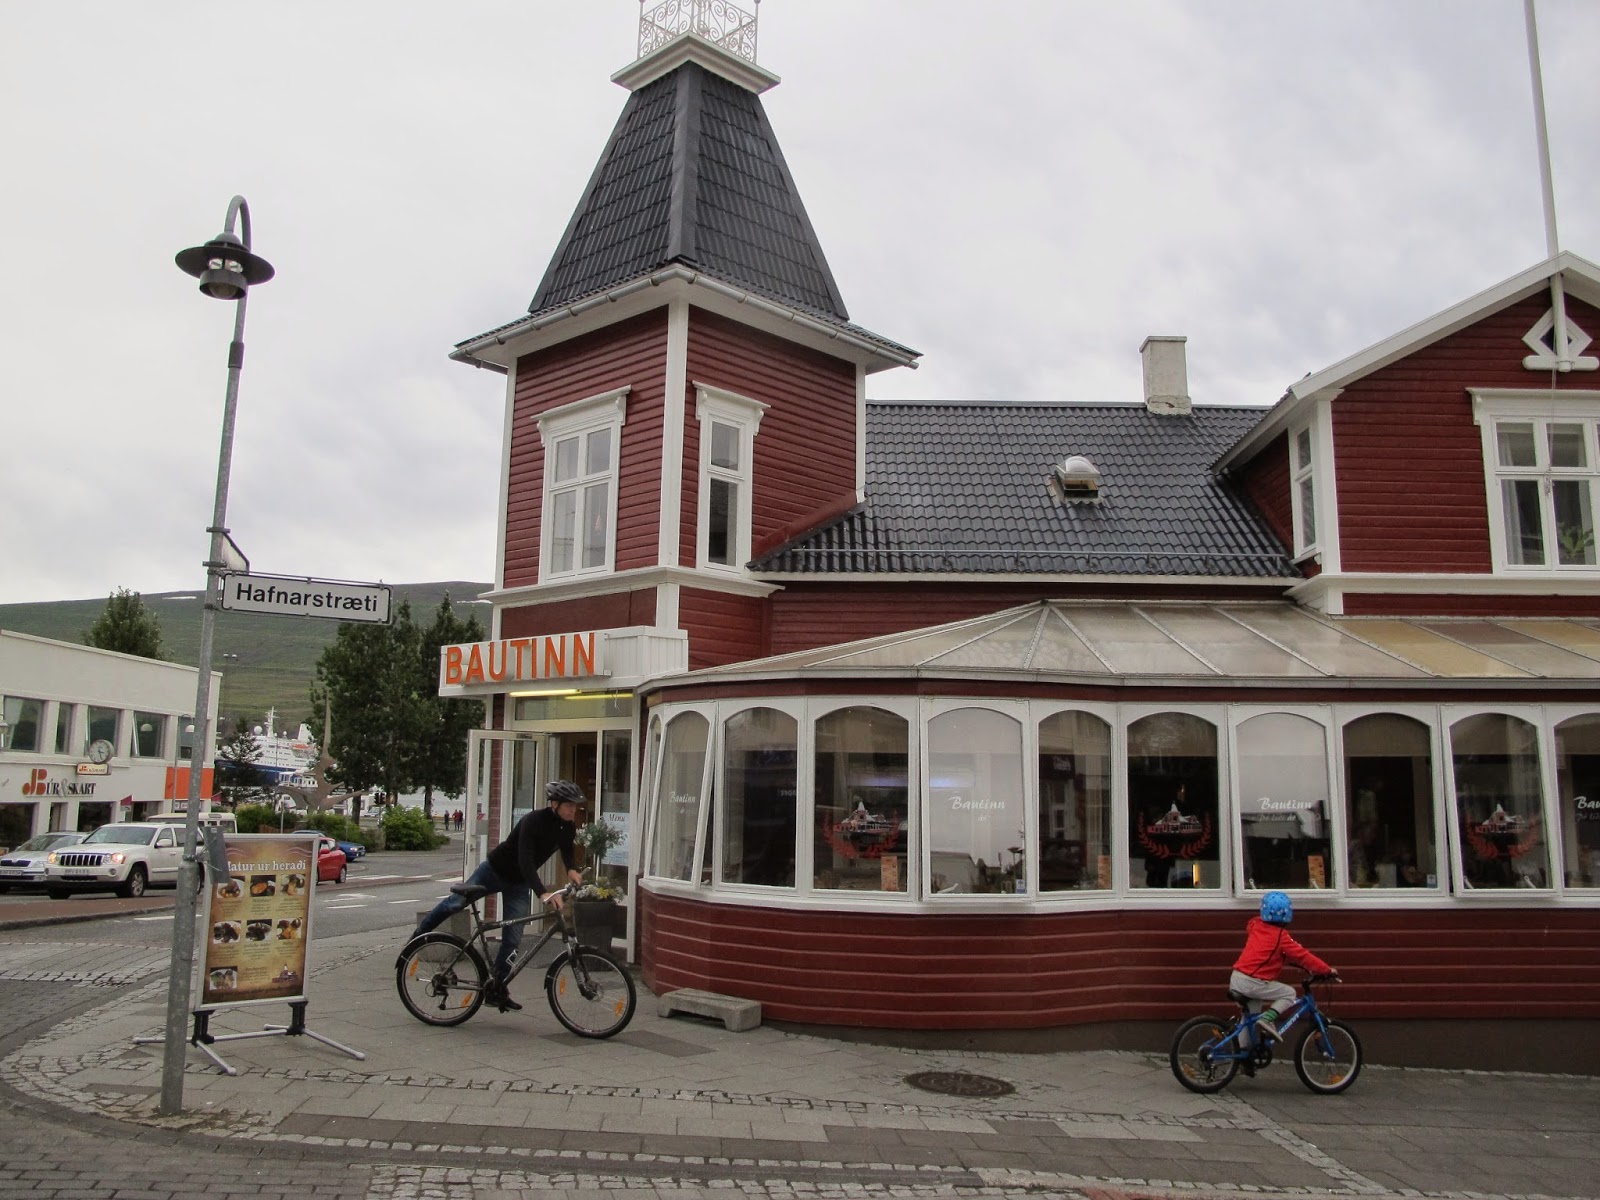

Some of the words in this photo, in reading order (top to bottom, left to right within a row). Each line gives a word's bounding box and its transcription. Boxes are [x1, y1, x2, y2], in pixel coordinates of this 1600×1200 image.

[236, 582, 378, 612] Hafnarstræti
[446, 632, 595, 685] BAUTINN
[669, 791, 696, 803] Bautinn
[948, 796, 1005, 810] Bautinn
[1257, 797, 1312, 810] Bautinn
